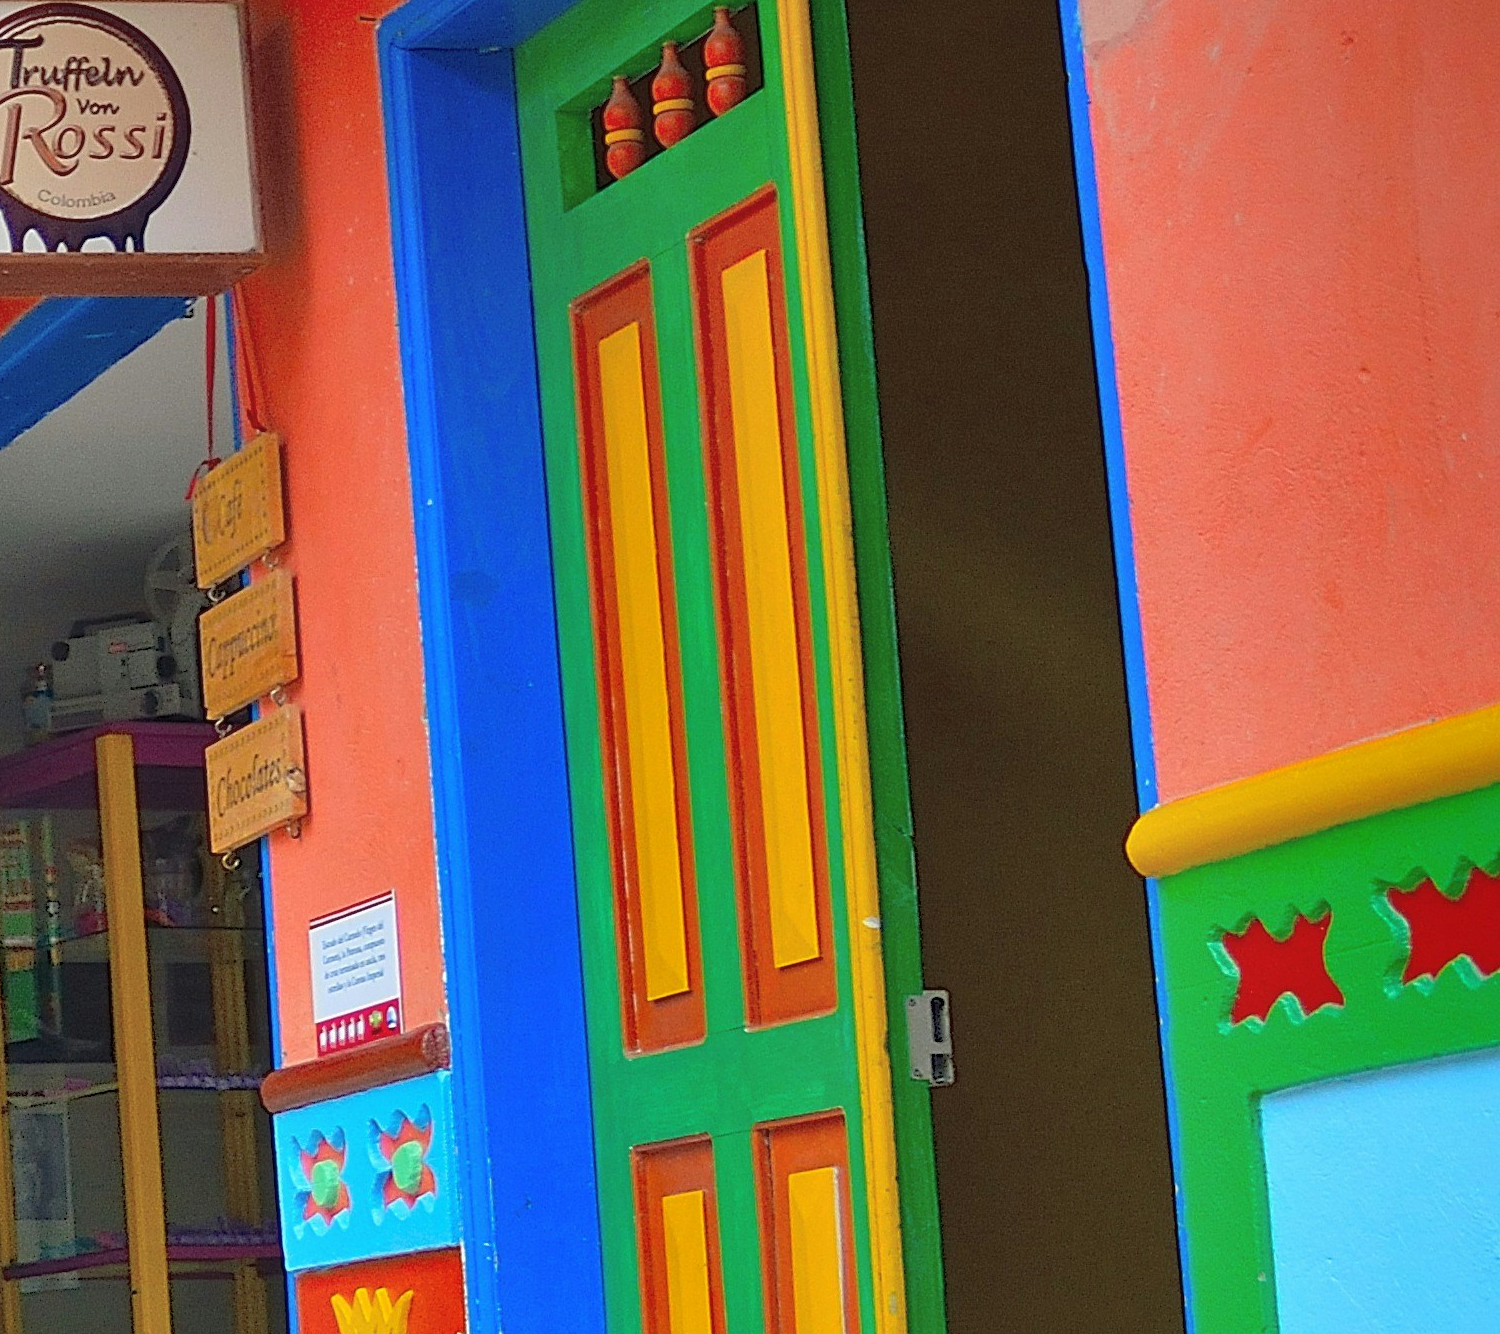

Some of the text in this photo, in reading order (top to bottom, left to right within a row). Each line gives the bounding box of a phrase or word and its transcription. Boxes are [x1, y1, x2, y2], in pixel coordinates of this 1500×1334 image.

[0, 34, 145, 92] Truffeln
[37, 189, 117, 209] Colombia
[216, 753, 282, 818] Chocolates
